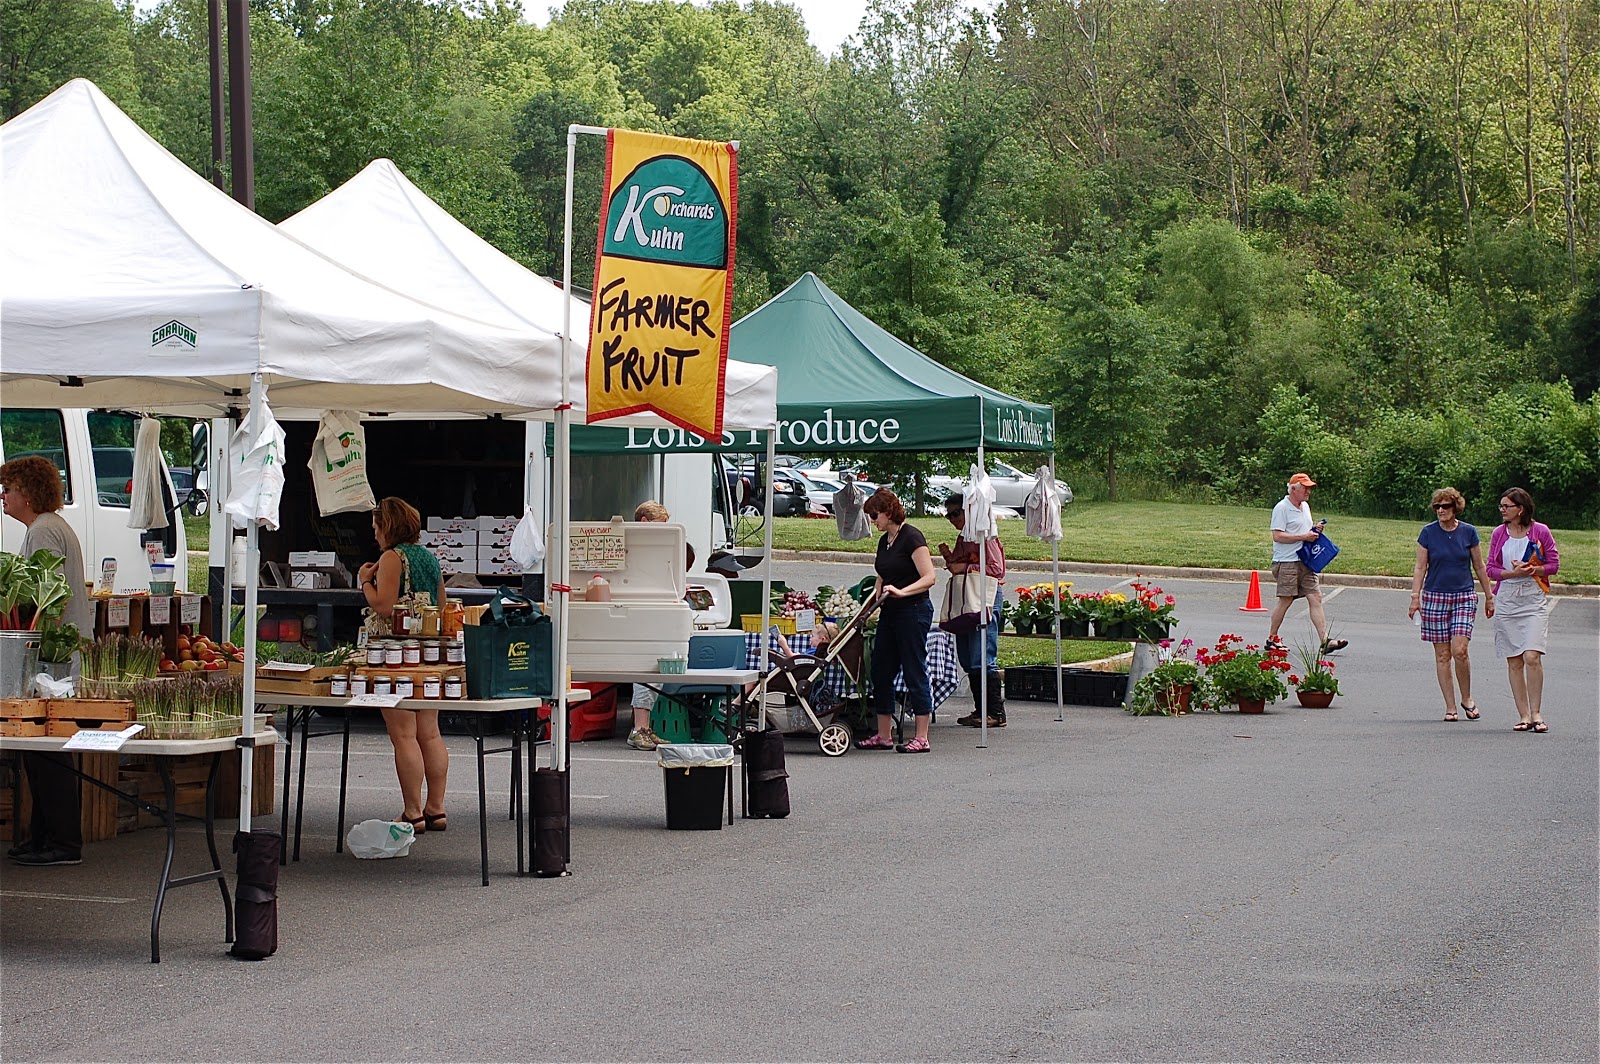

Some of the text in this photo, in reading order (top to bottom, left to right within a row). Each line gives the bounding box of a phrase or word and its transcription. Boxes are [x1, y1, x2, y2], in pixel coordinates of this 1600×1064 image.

[613, 185, 685, 251] Kuhn
[598, 277, 716, 338] FARMER
[152, 322, 197, 345] CARAVAN
[602, 335, 700, 393] FRUIT
[996, 407, 1044, 447] Lois's Produce
[580, 527, 596, 536] Apple
